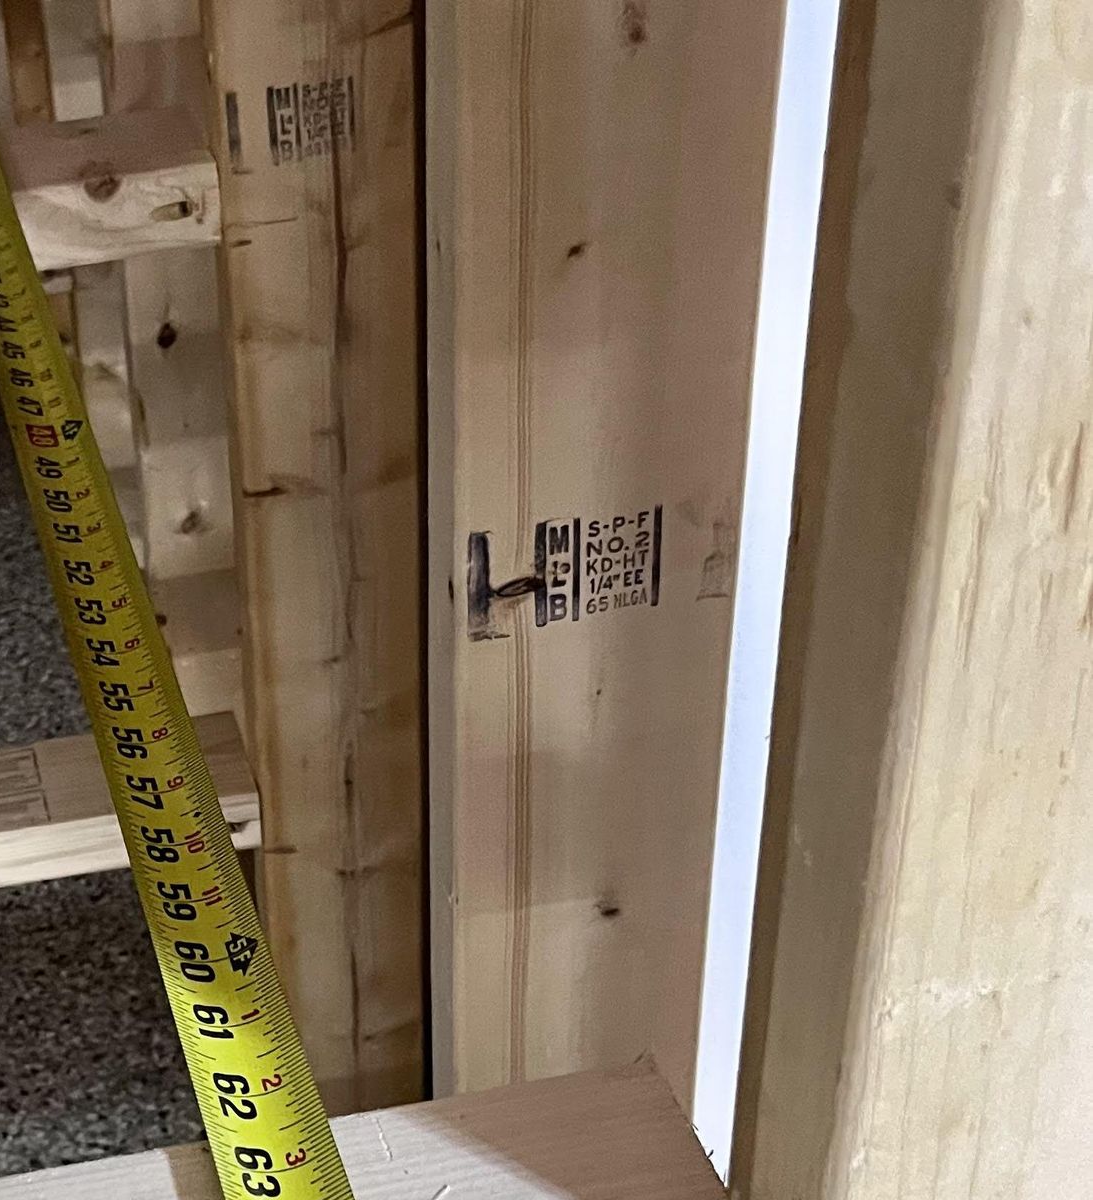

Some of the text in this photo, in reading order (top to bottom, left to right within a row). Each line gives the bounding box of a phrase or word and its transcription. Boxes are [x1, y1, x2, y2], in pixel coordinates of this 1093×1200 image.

[2, 341, 26, 360] 45
[9, 368, 34, 387] 46
[17, 396, 44, 416] 47
[34, 456, 63, 479] 49
[43, 489, 72, 513] 50
[53, 523, 83, 543] 51
[588, 511, 650, 537] S-P-F
[586, 531, 650, 558] NO. 2
[63, 559, 95, 586] 52
[586, 549, 649, 576] KD-HT
[623, 569, 644, 588] EE
[74, 598, 106, 625] 53
[586, 588, 648, 615] 65 NLGA
[86, 638, 120, 666] 54
[99, 680, 134, 712] 55
[112, 726, 148, 760] 56
[126, 774, 165, 810] 57
[76, 488, 90, 499] 2
[86, 522, 101, 534] 3
[99, 560, 114, 570] 4
[111, 597, 127, 609] 5
[124, 638, 140, 649] 6
[137, 679, 154, 691] 7
[152, 727, 168, 740] 8
[167, 775, 184, 789] 9
[184, 830, 205, 854] 10
[202, 886, 223, 906] 11
[229, 937, 252, 973] 5F
[241, 1008, 260, 1021] 1
[261, 1073, 283, 1092] 2
[285, 1147, 306, 1166] 3
[140, 825, 179, 863] 58
[157, 881, 197, 921] 59
[174, 940, 216, 983] 60
[193, 1004, 234, 1040] 61
[213, 1072, 257, 1120] 62
[234, 1146, 281, 1198] 63
